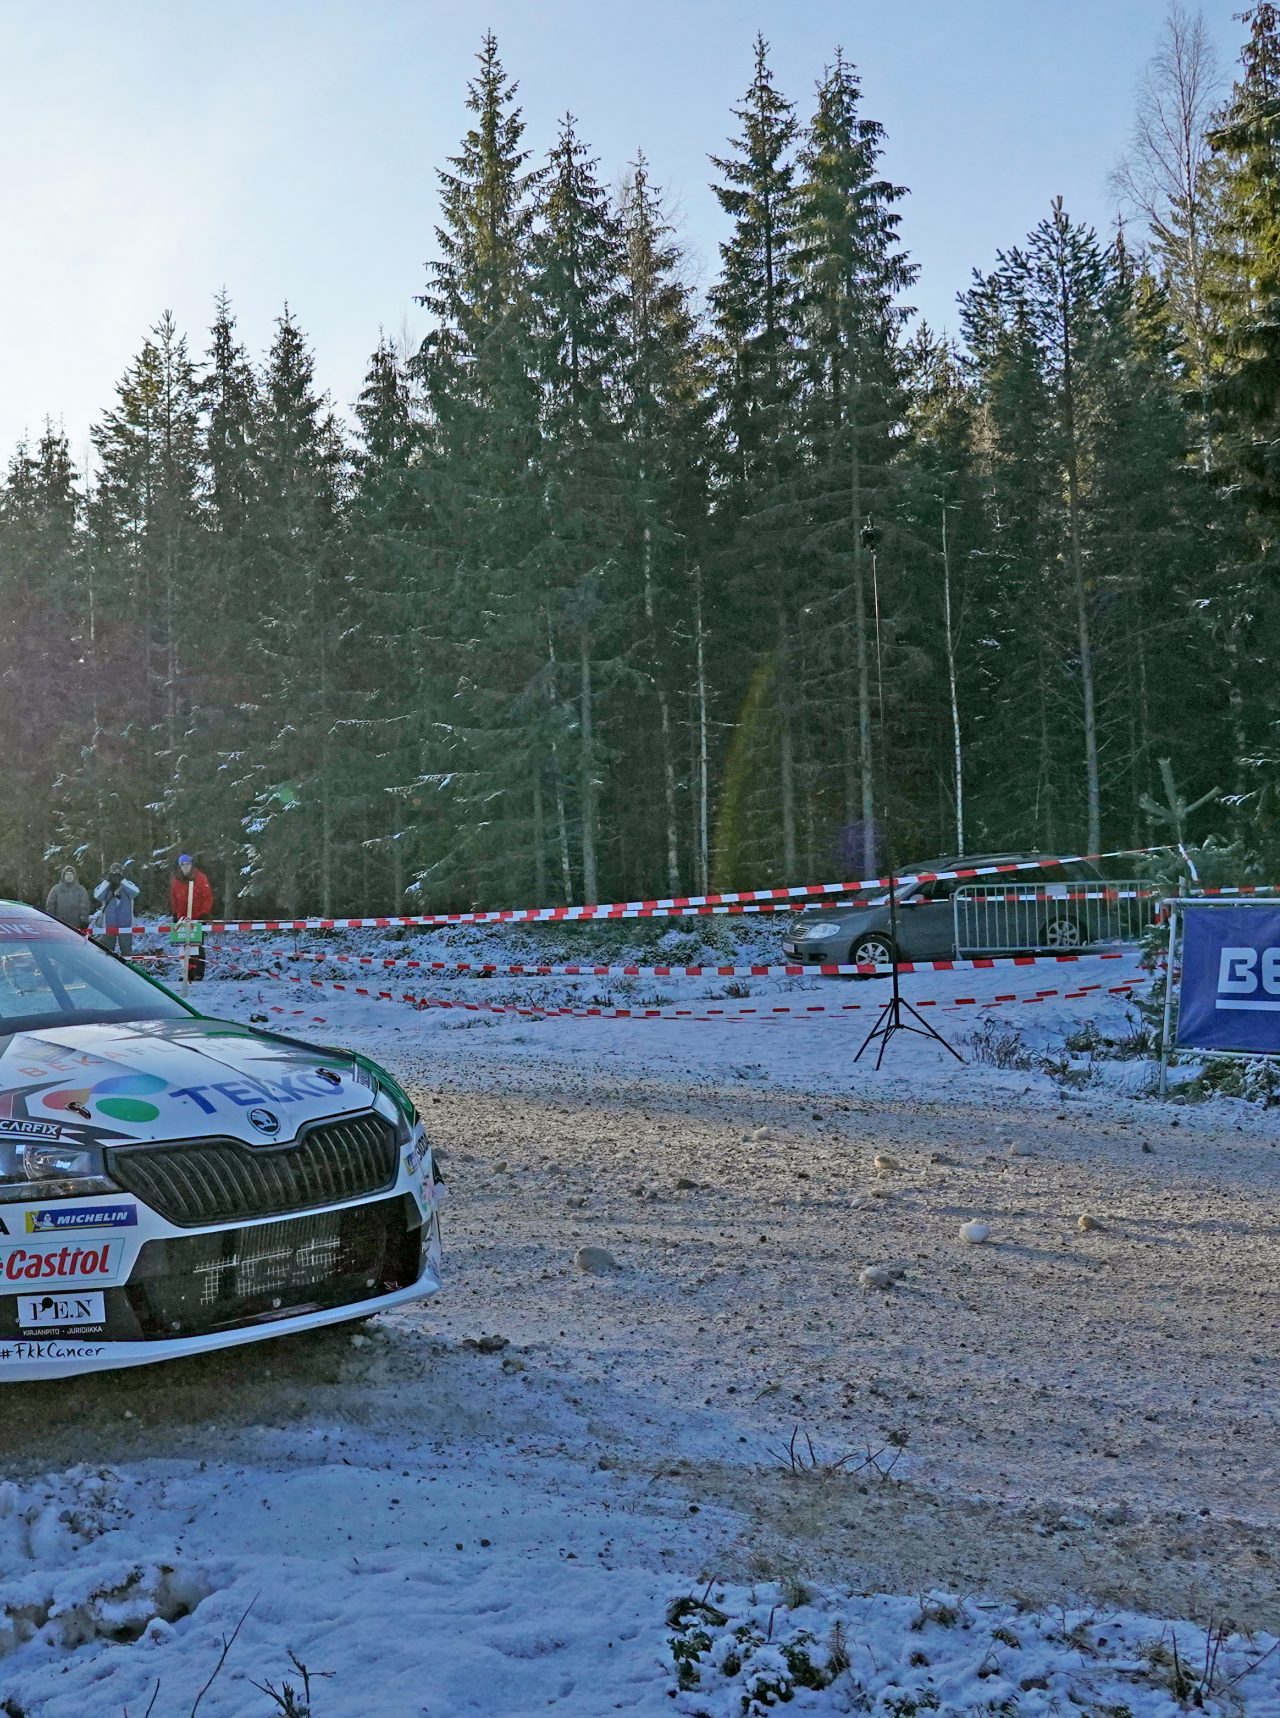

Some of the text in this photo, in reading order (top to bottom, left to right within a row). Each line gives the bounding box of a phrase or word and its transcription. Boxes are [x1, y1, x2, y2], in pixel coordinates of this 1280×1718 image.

[168, 1073, 344, 1115] TELKO
[56, 1211, 128, 1225] MICHELIN
[6, 1244, 111, 1281] Castrol
[23, 1325, 103, 1337] KIRJANPITO JURIDIIKKA
